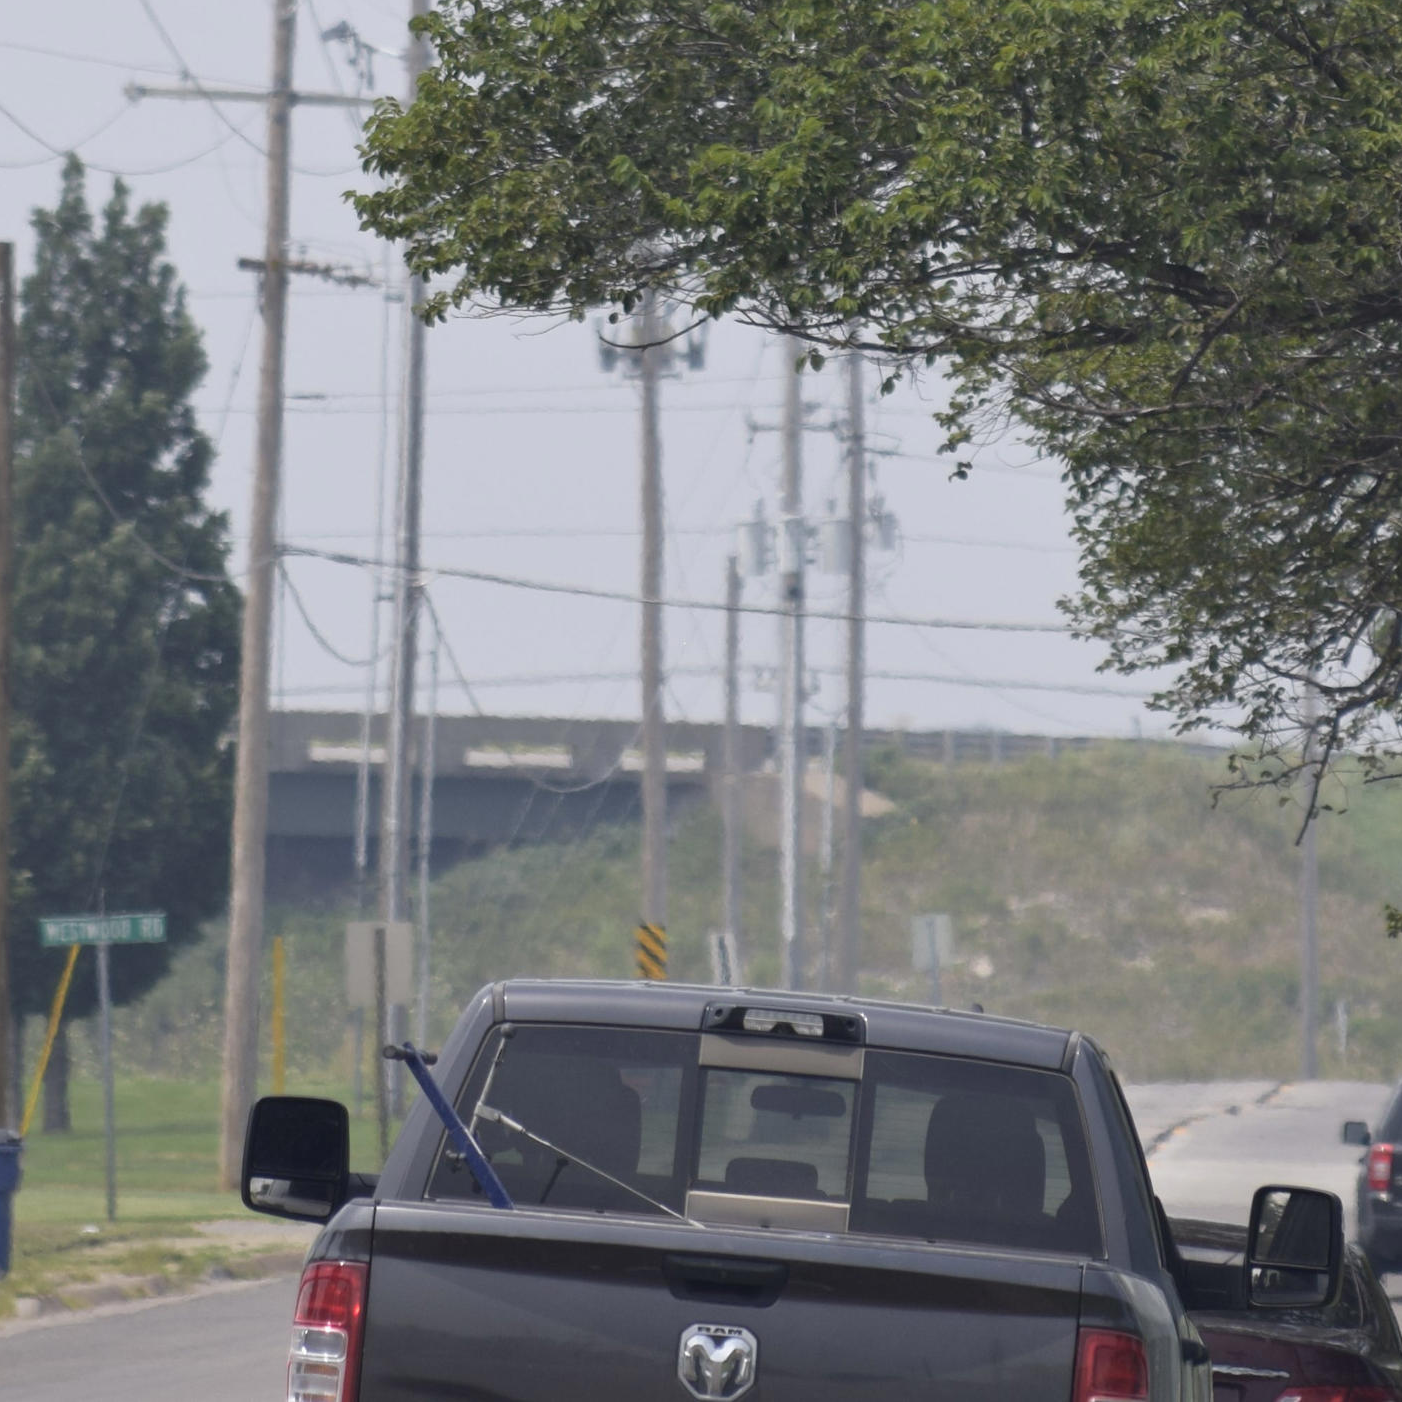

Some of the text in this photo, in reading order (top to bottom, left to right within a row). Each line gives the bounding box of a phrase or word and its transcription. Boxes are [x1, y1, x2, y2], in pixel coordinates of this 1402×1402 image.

[45, 917, 164, 943] WESTWOOD RD
[697, 1326, 743, 1336] RAM
